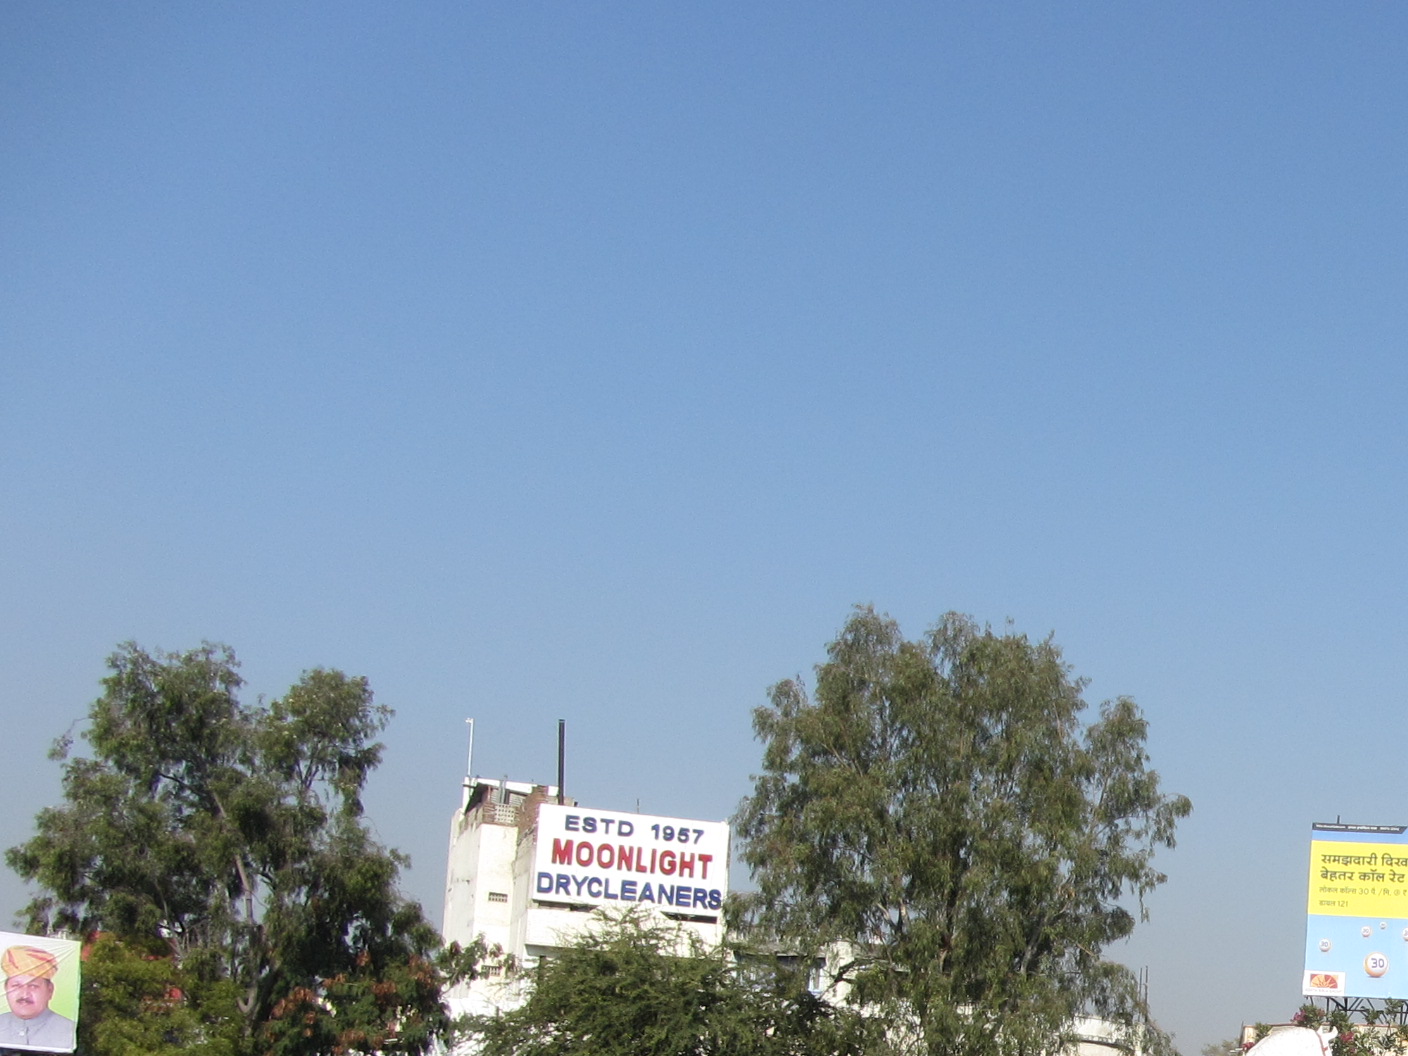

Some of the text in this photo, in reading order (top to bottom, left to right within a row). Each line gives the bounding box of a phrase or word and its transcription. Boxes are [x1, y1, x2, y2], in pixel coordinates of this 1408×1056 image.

[565, 814, 704, 844] ESTD 1957
[551, 838, 713, 880] MOONLIGHT
[1321, 852, 1377, 866] समझदारी
[1320, 866, 1355, 882] बेहतर
[1358, 868, 1385, 882] कॉल
[1389, 869, 1405, 883] रेट
[536, 871, 722, 910] DRYCLEANERS
[1371, 958, 1385, 968] 30
